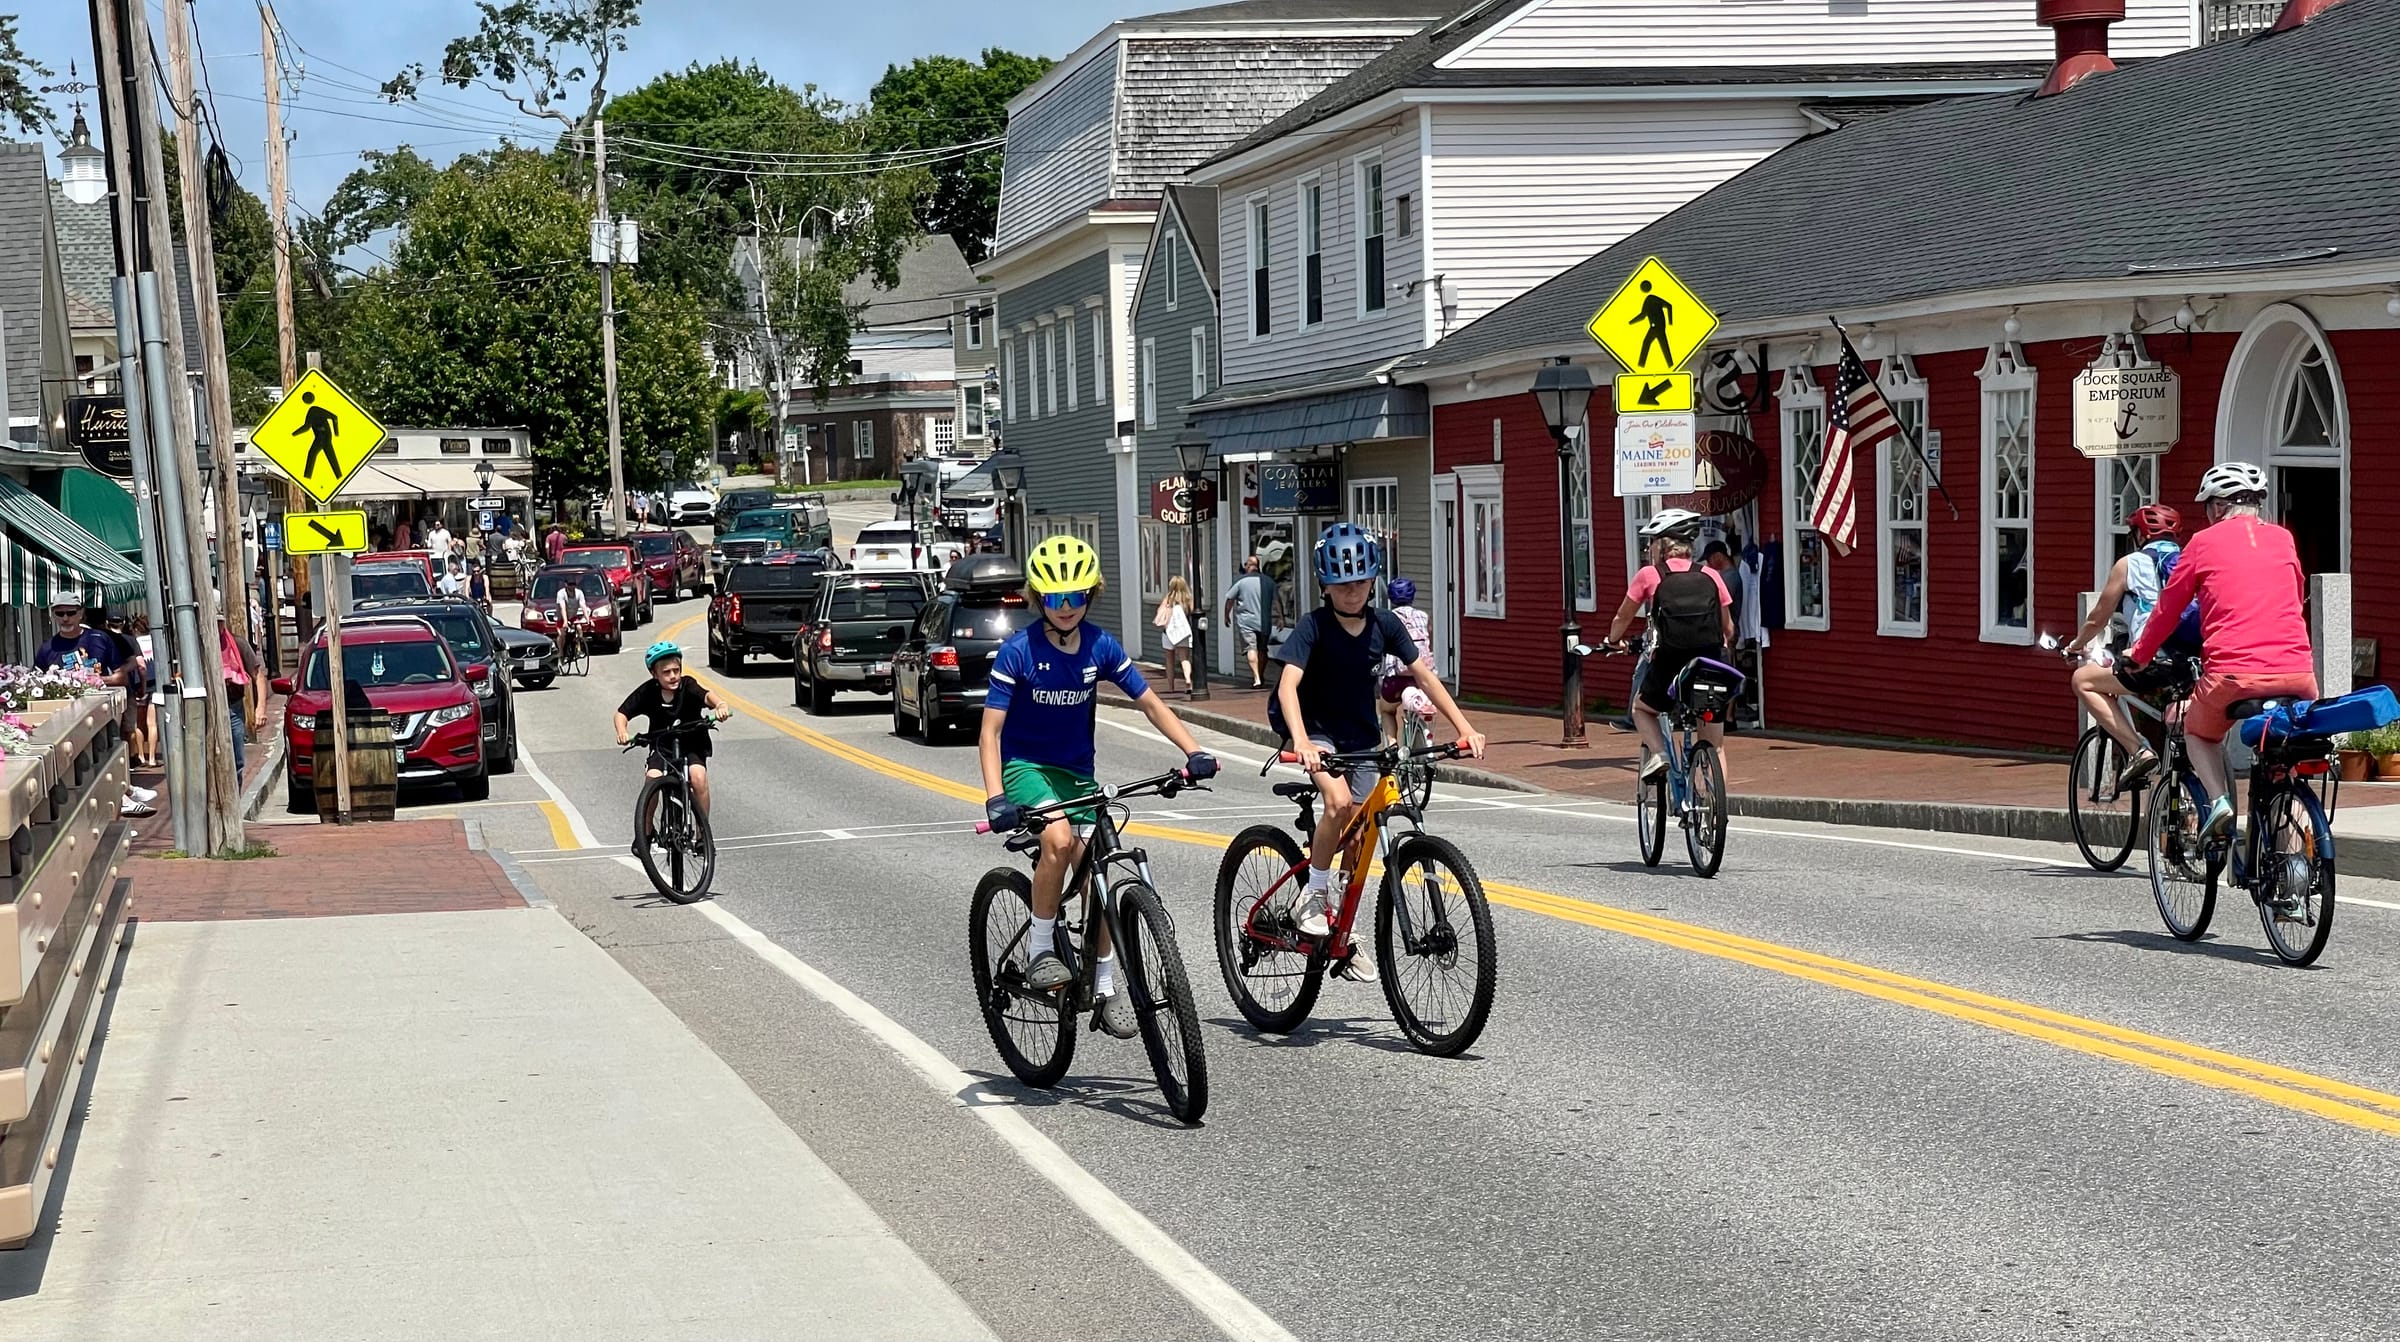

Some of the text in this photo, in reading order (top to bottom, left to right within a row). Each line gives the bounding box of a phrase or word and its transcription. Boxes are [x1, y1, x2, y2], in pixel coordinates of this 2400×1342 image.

[2083, 373, 2172, 386] DOCK SQUARE
[2089, 386, 2166, 401] EMPORIUM
[81, 404, 128, 431] Hurric
[1655, 419, 1688, 429] Celebration
[1695, 434, 1756, 466] XONY
[1264, 467, 1335, 480] COASTAL
[1159, 476, 1208, 493] FLAMG
[1275, 480, 1327, 490] JEWELERS
[1161, 507, 1209, 524] GOURET
